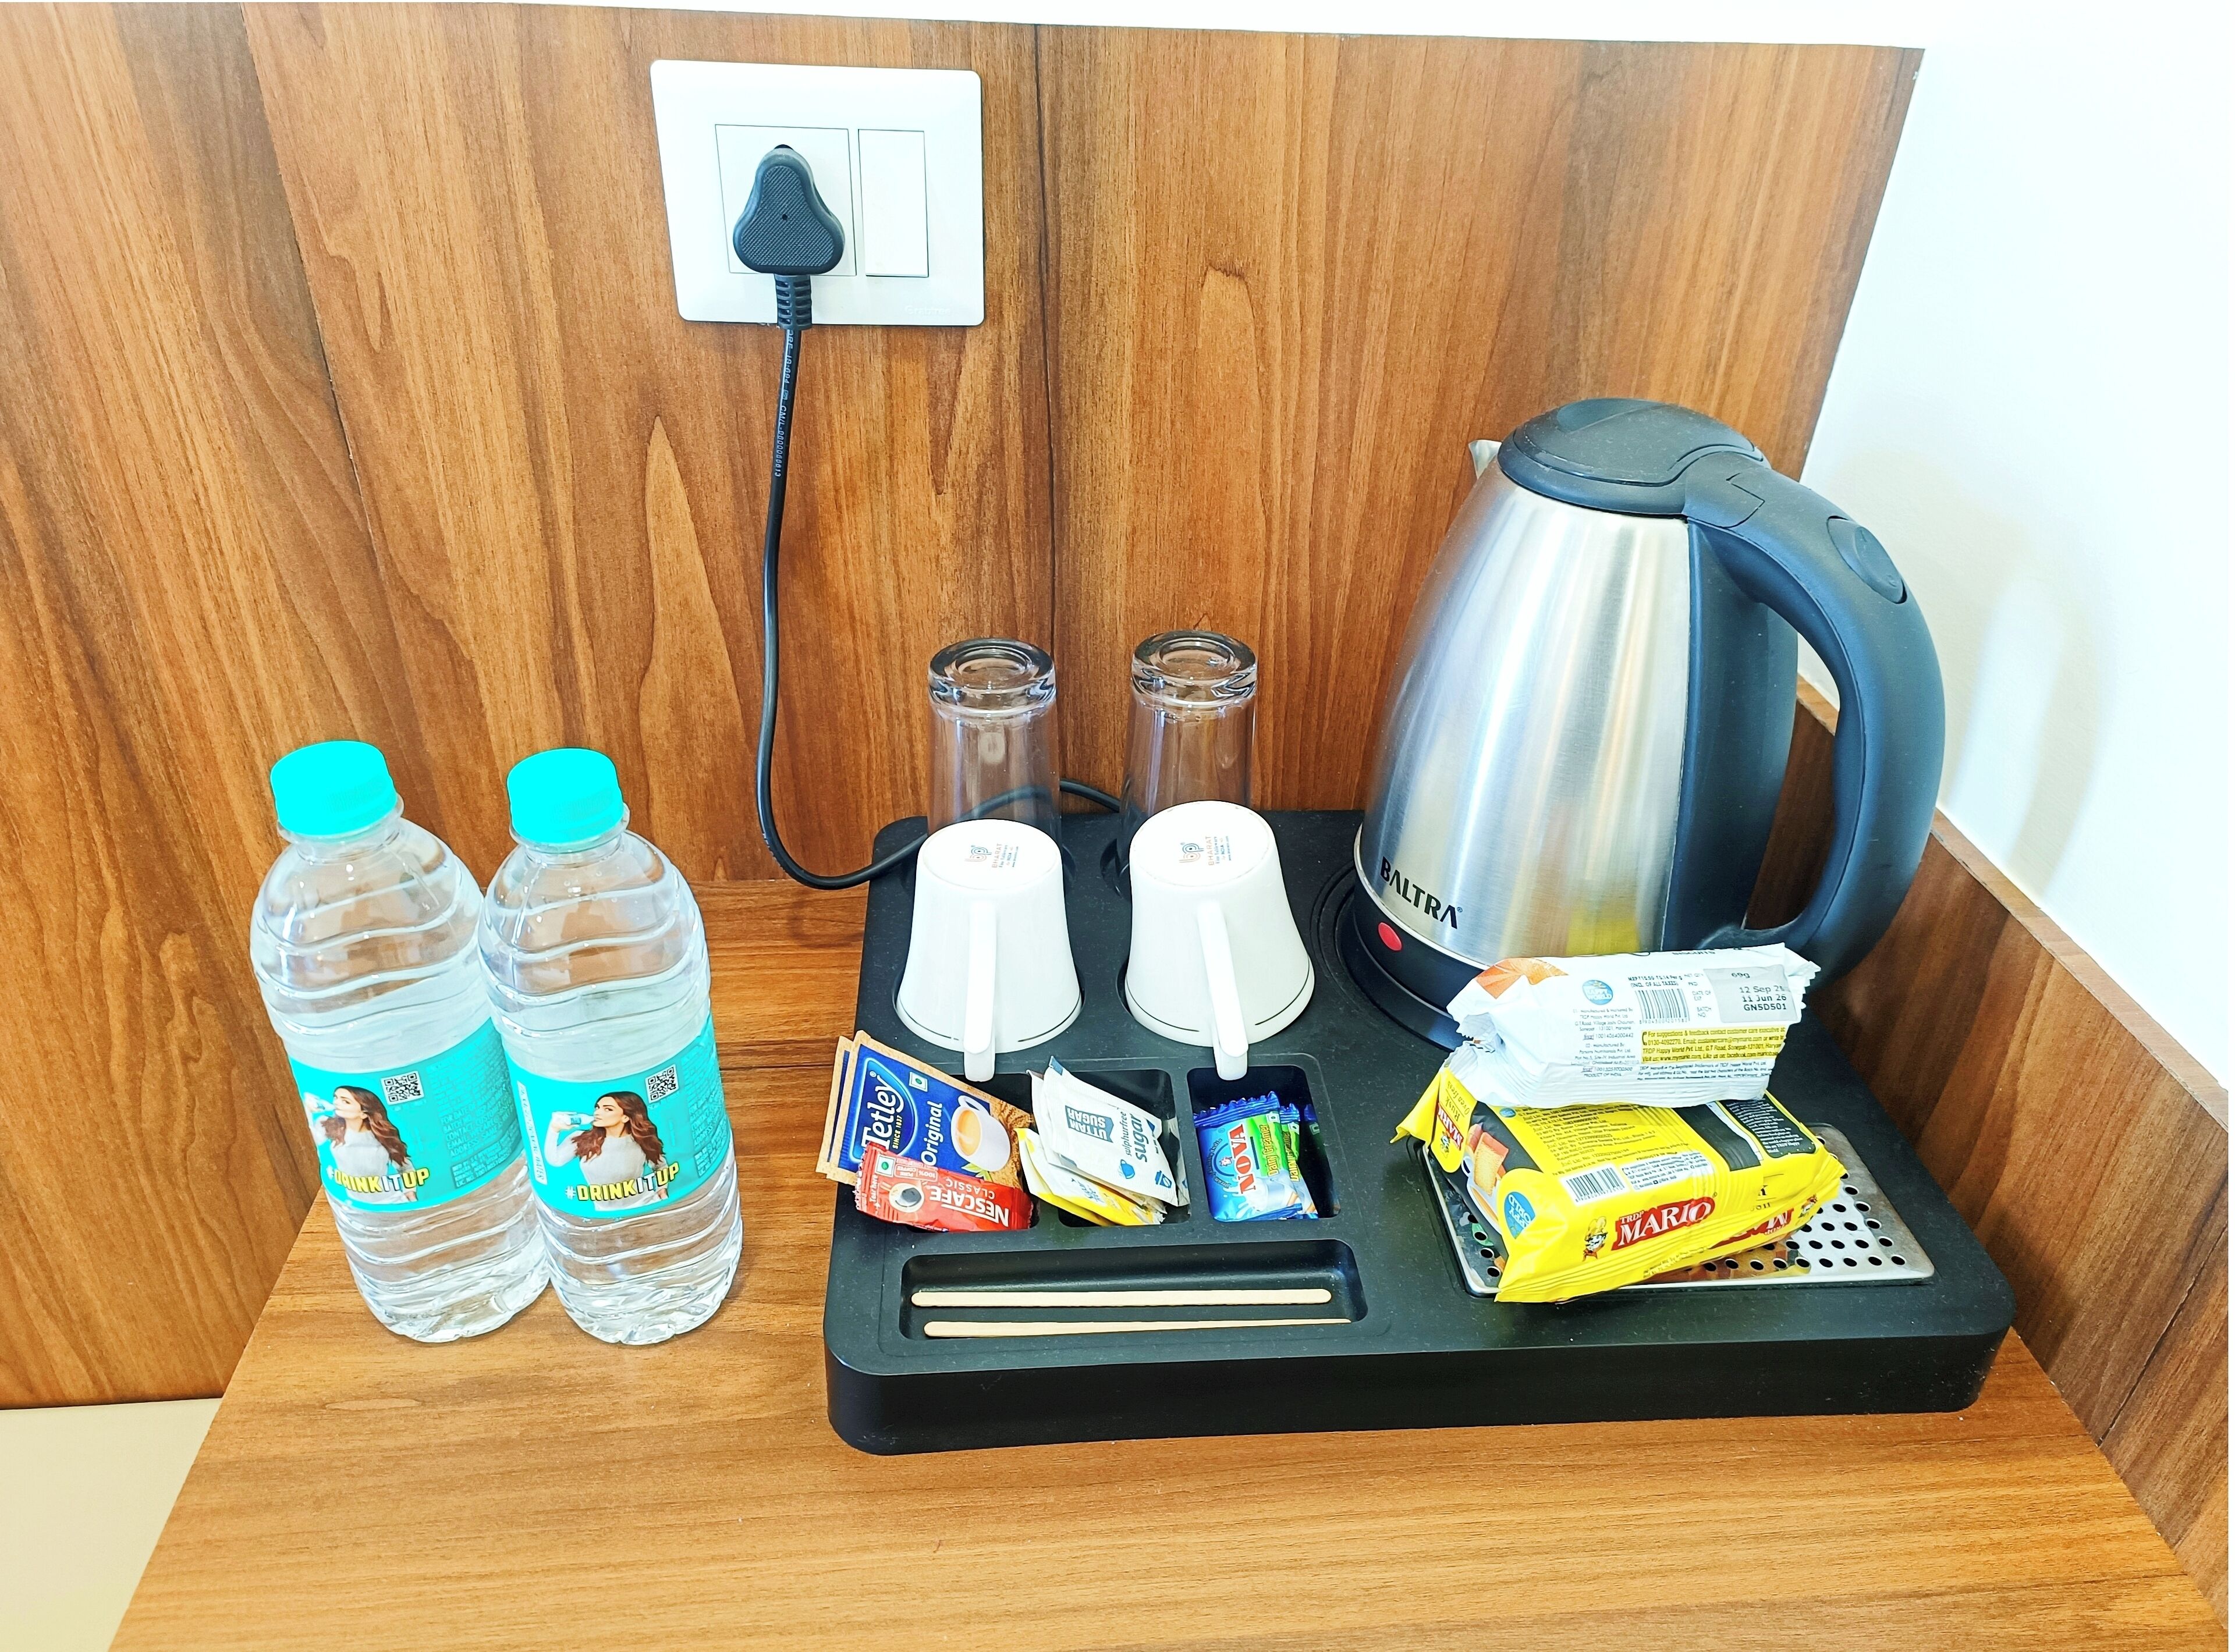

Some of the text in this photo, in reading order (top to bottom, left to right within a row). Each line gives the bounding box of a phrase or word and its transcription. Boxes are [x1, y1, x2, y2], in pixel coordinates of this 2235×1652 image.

[1205, 836, 1214, 865] BHARAT
[1380, 857, 1457, 929] BALTRA
[1753, 986, 1771, 994] Sep
[861, 1075, 904, 1150] Tetley
[1068, 1107, 1106, 1128] SUGAR
[1445, 1096, 1460, 1122] Rusk
[892, 1129, 901, 1149] SINCE
[921, 1101, 944, 1166] Original
[1070, 1120, 1108, 1141] UTTAM
[1120, 1111, 1132, 1156] sulphurfree
[1130, 1113, 1149, 1163] sugar
[1230, 1124, 1256, 1194] NOVA
[1260, 1124, 1280, 1176] Dairy Creamer
[326, 1167, 430, 1193] #DRINKITUP
[565, 1162, 680, 1201] #DRINKITUP
[946, 1178, 995, 1200] CLASSIC
[1617, 1201, 1712, 1247] MARIO
[1620, 1210, 1644, 1225] TRDP
